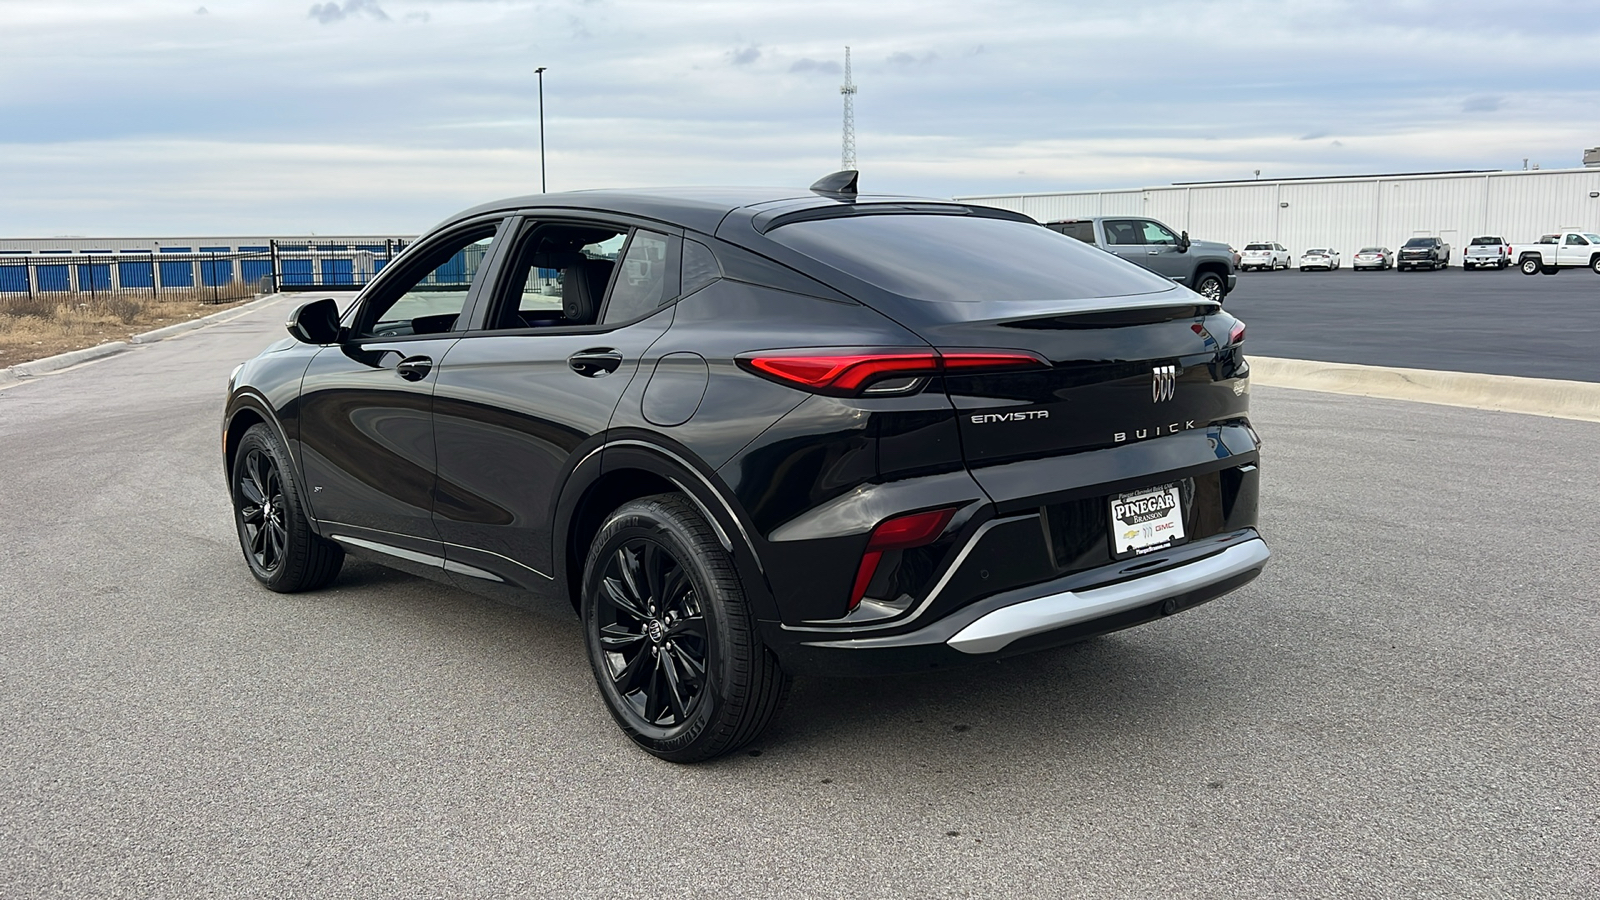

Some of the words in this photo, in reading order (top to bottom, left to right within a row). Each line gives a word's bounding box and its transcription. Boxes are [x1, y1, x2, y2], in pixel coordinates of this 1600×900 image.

[971, 410, 1049, 424] ENVISTA
[1113, 419, 1195, 443] BUICK
[1115, 494, 1175, 519] PINEGAR
[1133, 511, 1163, 524] BRANSON
[1155, 521, 1175, 532] GMC
